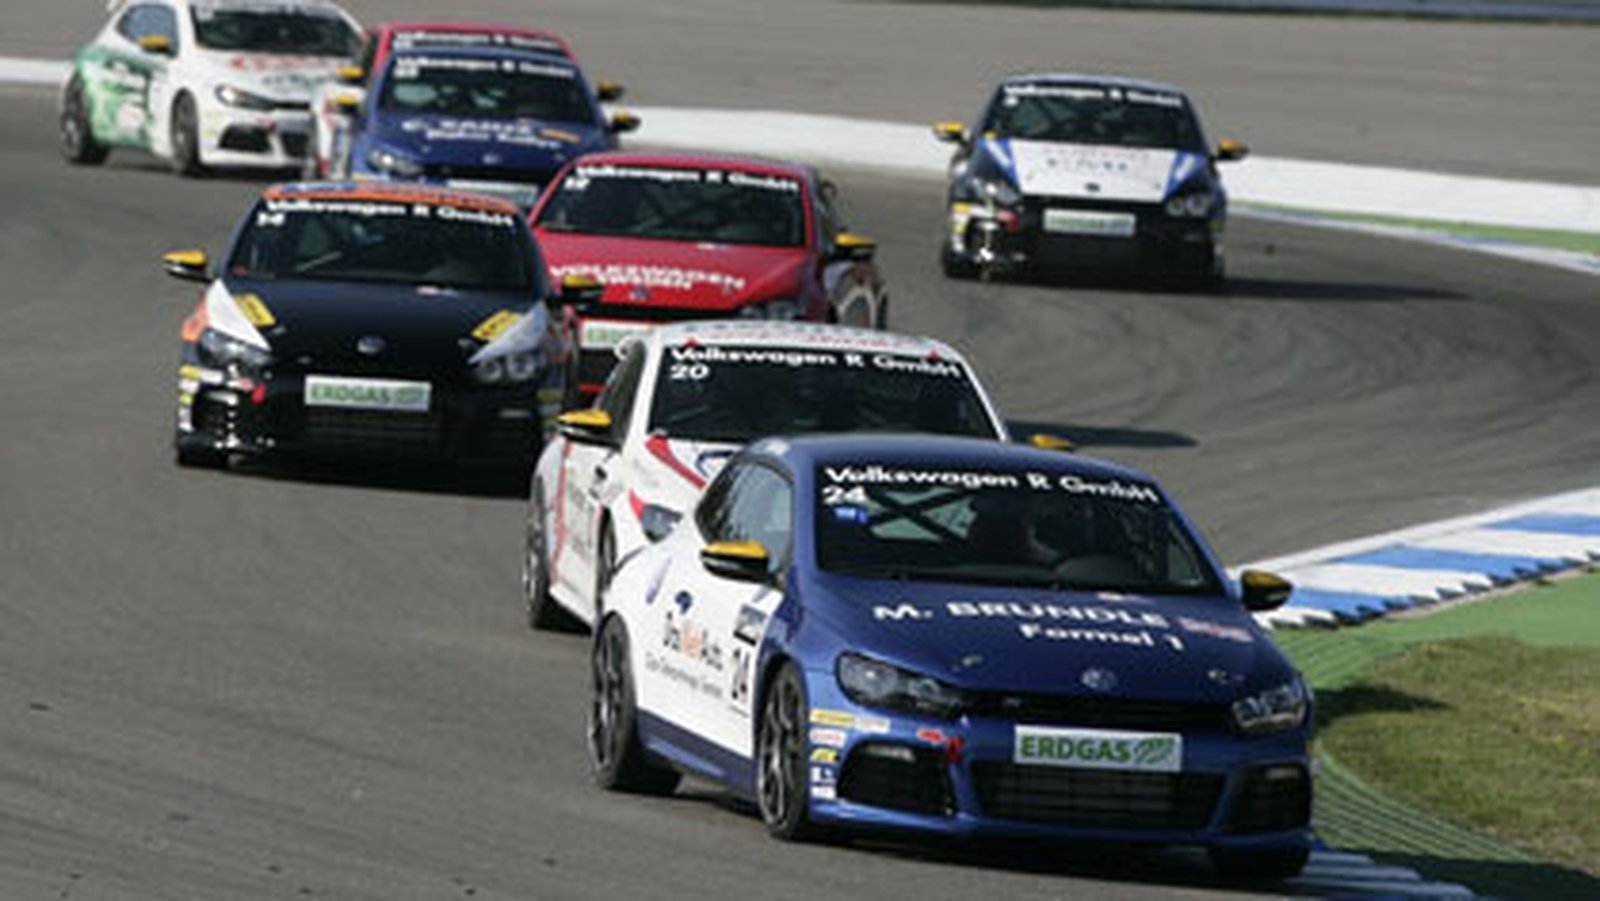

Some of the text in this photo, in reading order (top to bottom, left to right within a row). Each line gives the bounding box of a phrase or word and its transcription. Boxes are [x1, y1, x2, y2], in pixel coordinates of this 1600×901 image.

[575, 166, 700, 182] Volkswagen
[706, 171, 722, 183] R
[267, 198, 514, 227] Volkswagen R GmbH
[670, 361, 710, 381] 20
[671, 346, 962, 379] Volkswagen R GmbH
[310, 384, 392, 404] ERDGAS
[822, 485, 868, 505] 24
[823, 465, 1161, 504] Volkswagen R GmbH
[873, 601, 1171, 629] M. BRUNDLE
[1018, 622, 1185, 652] Formel 1
[1020, 735, 1132, 764] ERDGAS
